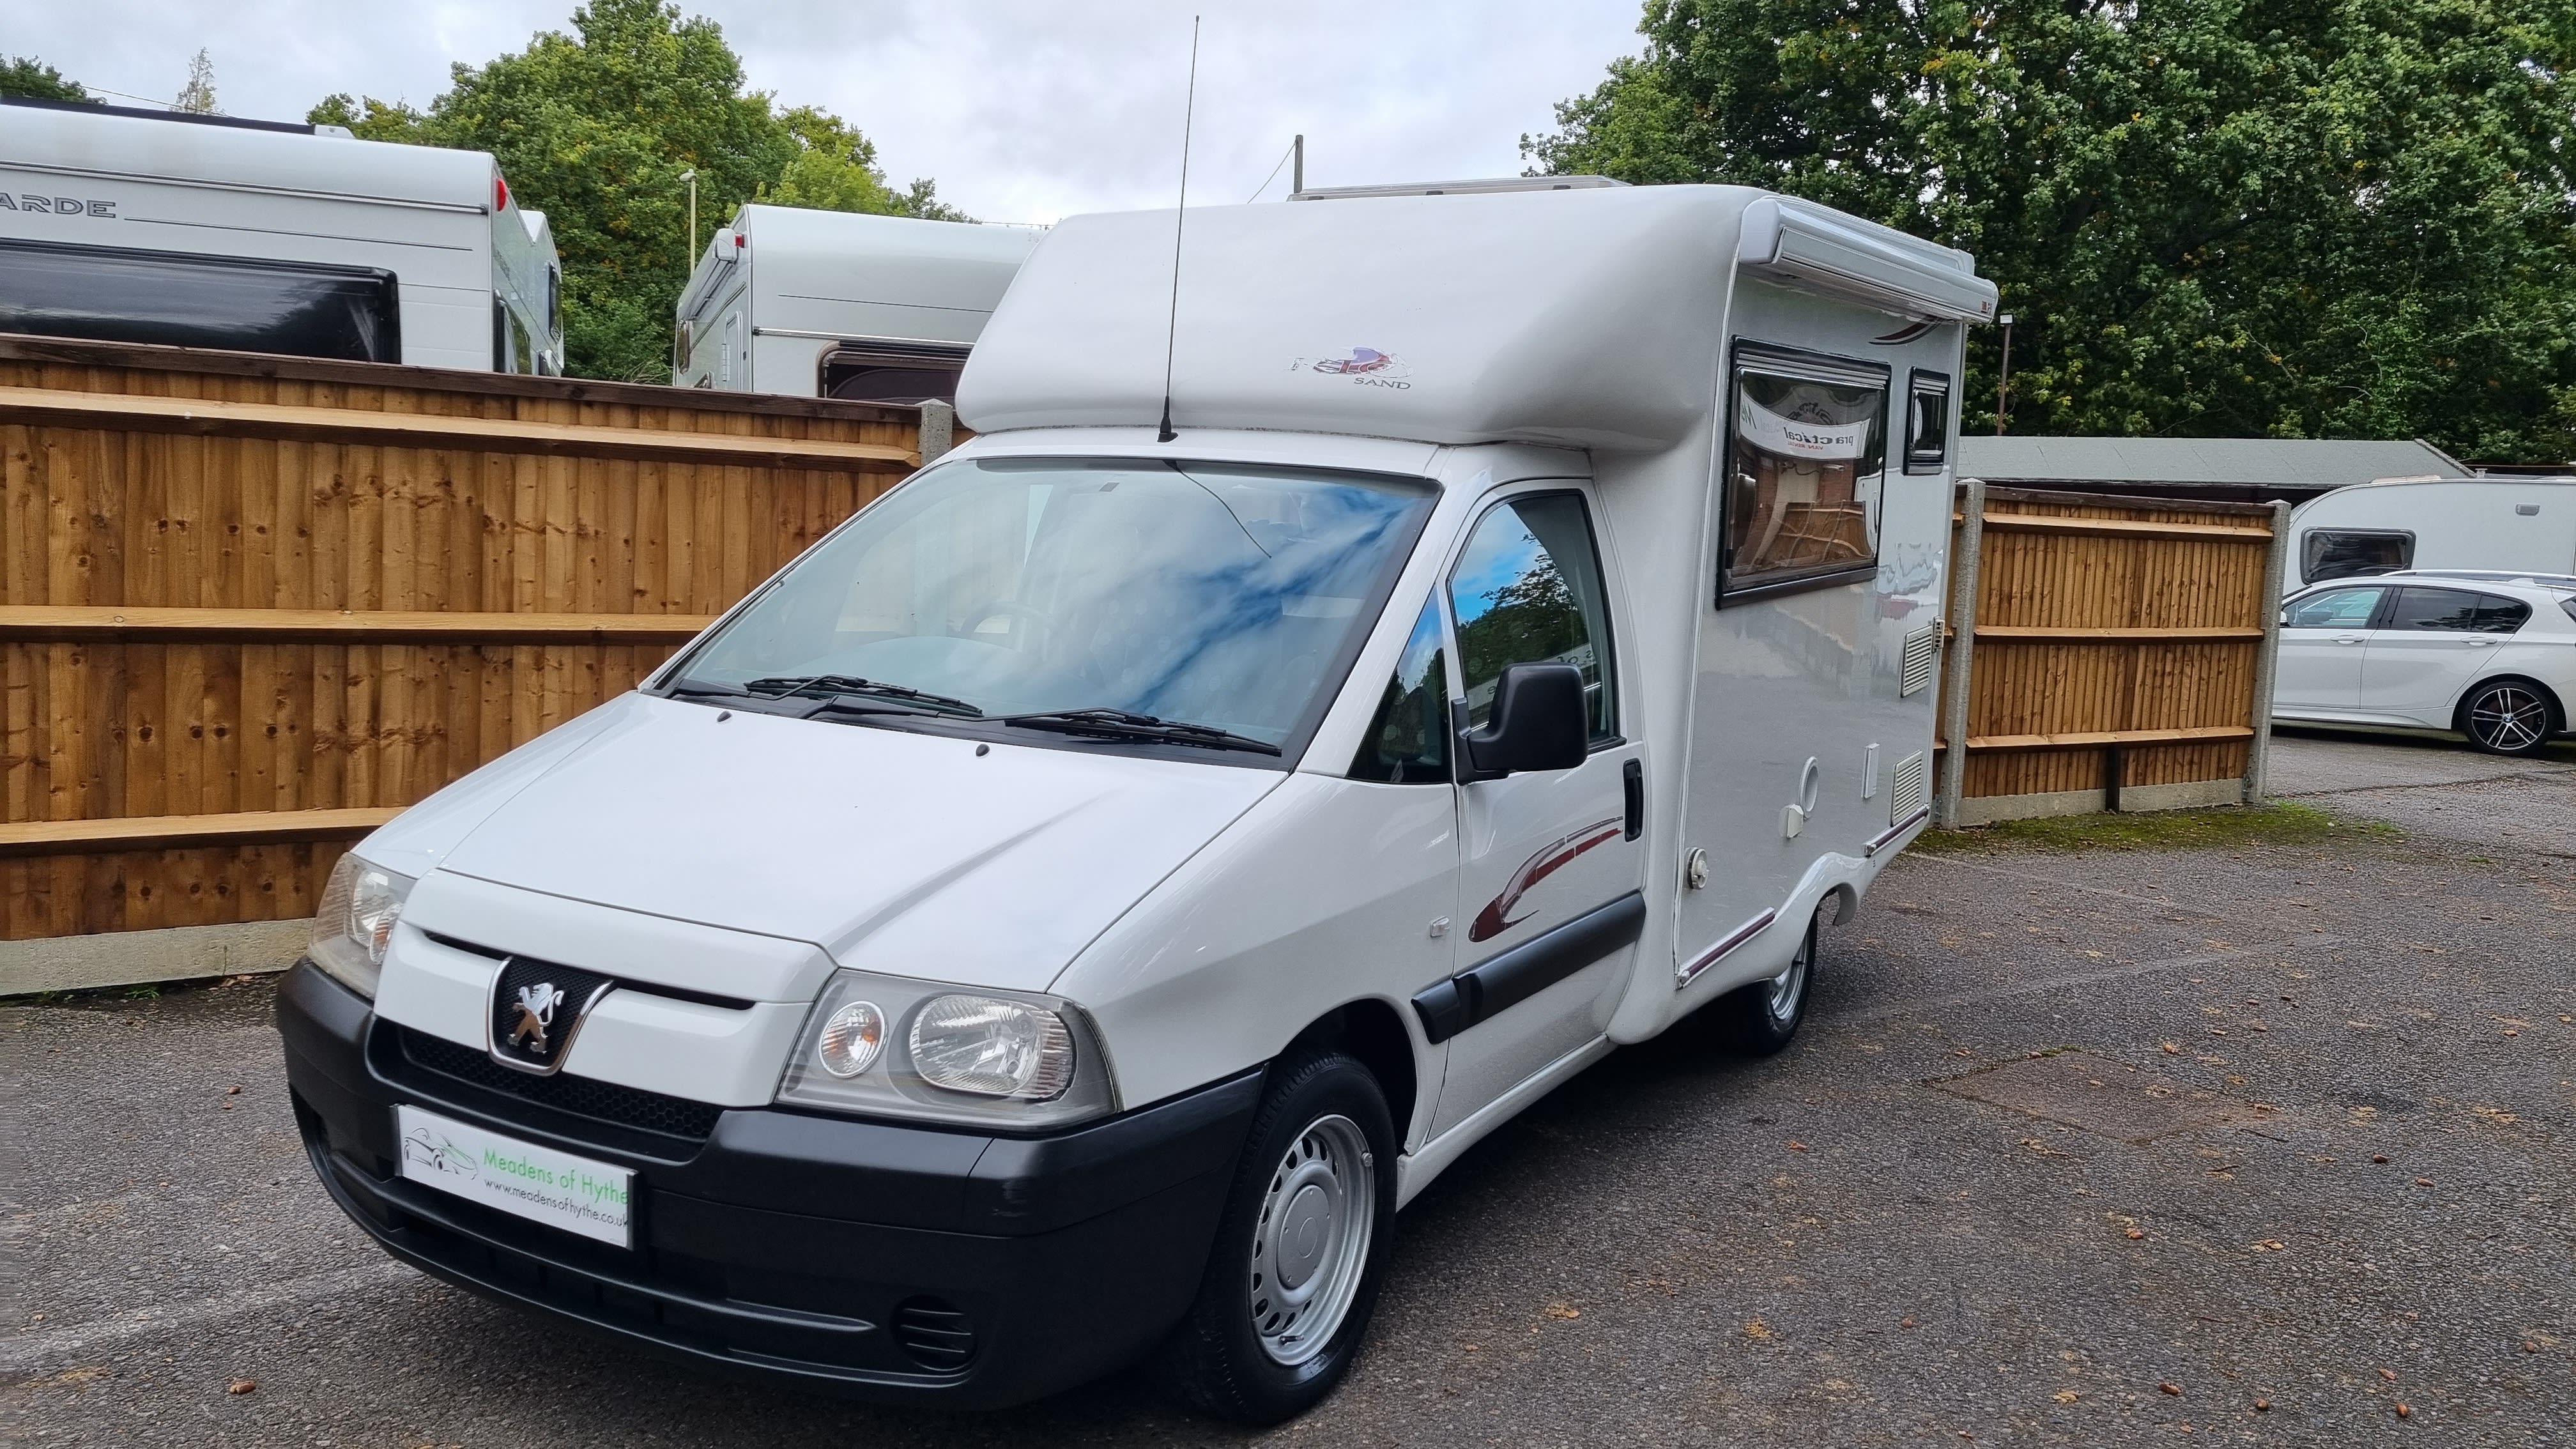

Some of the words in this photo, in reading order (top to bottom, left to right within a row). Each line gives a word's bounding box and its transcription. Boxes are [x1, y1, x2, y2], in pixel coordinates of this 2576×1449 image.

[1354, 378, 1411, 389] SAND
[484, 1148, 553, 1184] Meadens
[560, 1170, 576, 1191] of
[582, 1174, 629, 1204] Hythe
[484, 1179, 629, 1227] www.meadensofhythe.co.uk
